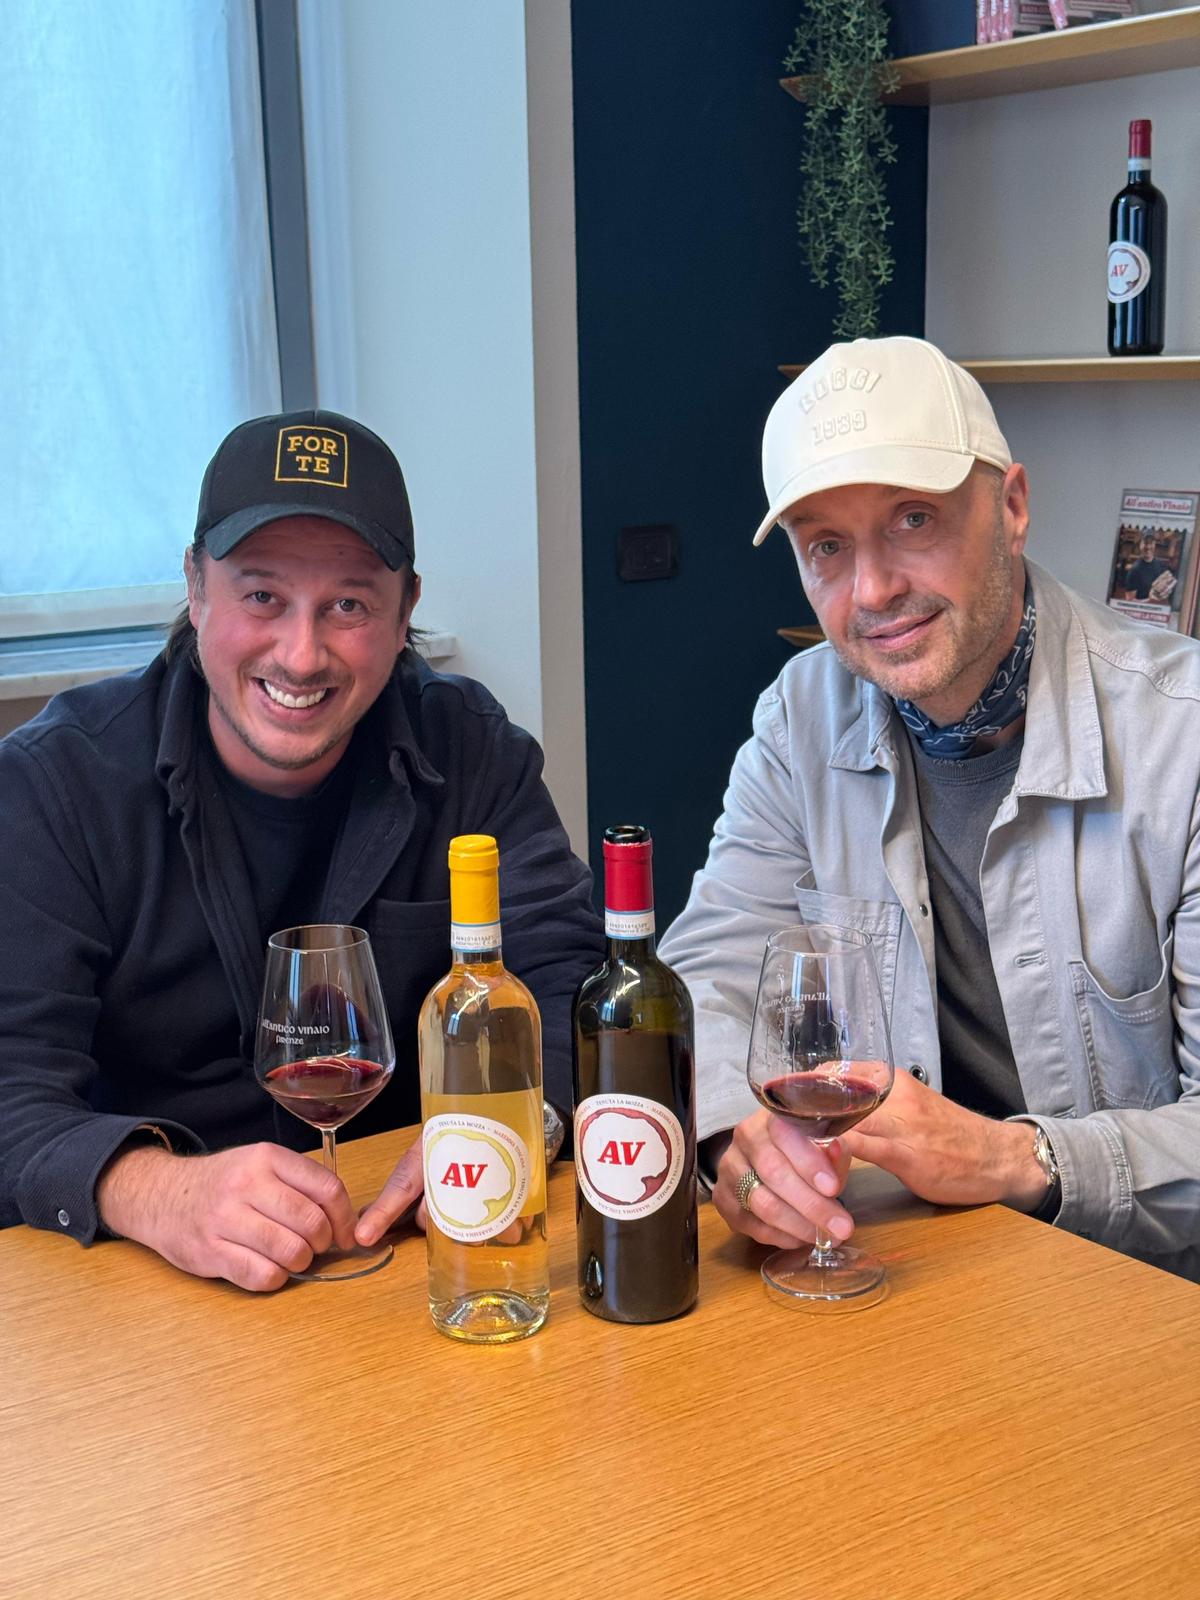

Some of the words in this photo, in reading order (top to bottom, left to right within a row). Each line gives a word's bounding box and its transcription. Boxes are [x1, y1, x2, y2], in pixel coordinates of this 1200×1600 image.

[1110, 264, 1129, 277] AV
[287, 435, 338, 456] FOR
[295, 455, 330, 474] TE
[439, 1119, 457, 1128] TENUTA
[466, 1121, 486, 1130] MOZZA
[597, 1140, 646, 1166] AV
[440, 1162, 488, 1189] AV
